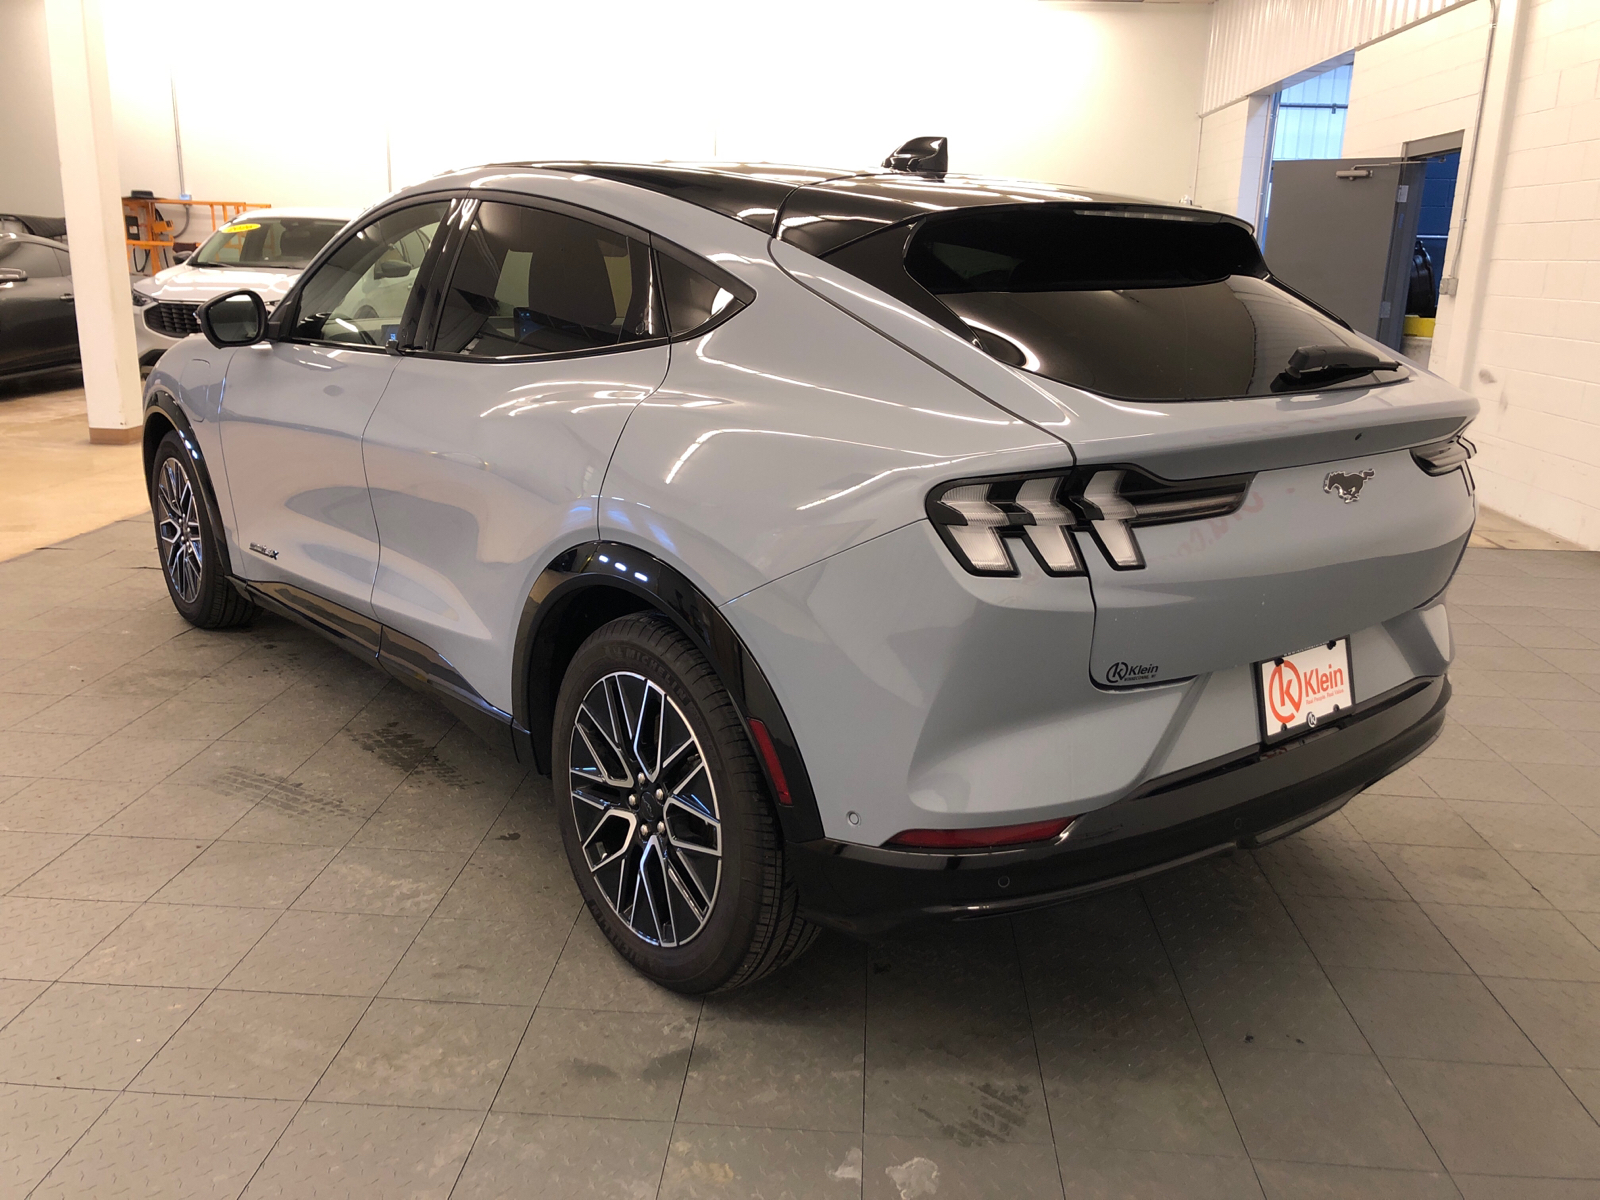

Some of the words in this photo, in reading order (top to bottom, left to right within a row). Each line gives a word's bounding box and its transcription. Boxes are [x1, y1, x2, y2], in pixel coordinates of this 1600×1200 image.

[624, 648, 689, 703] MICHELIN
[1128, 664, 1159, 676] Klein
[1303, 663, 1344, 698] Klein
